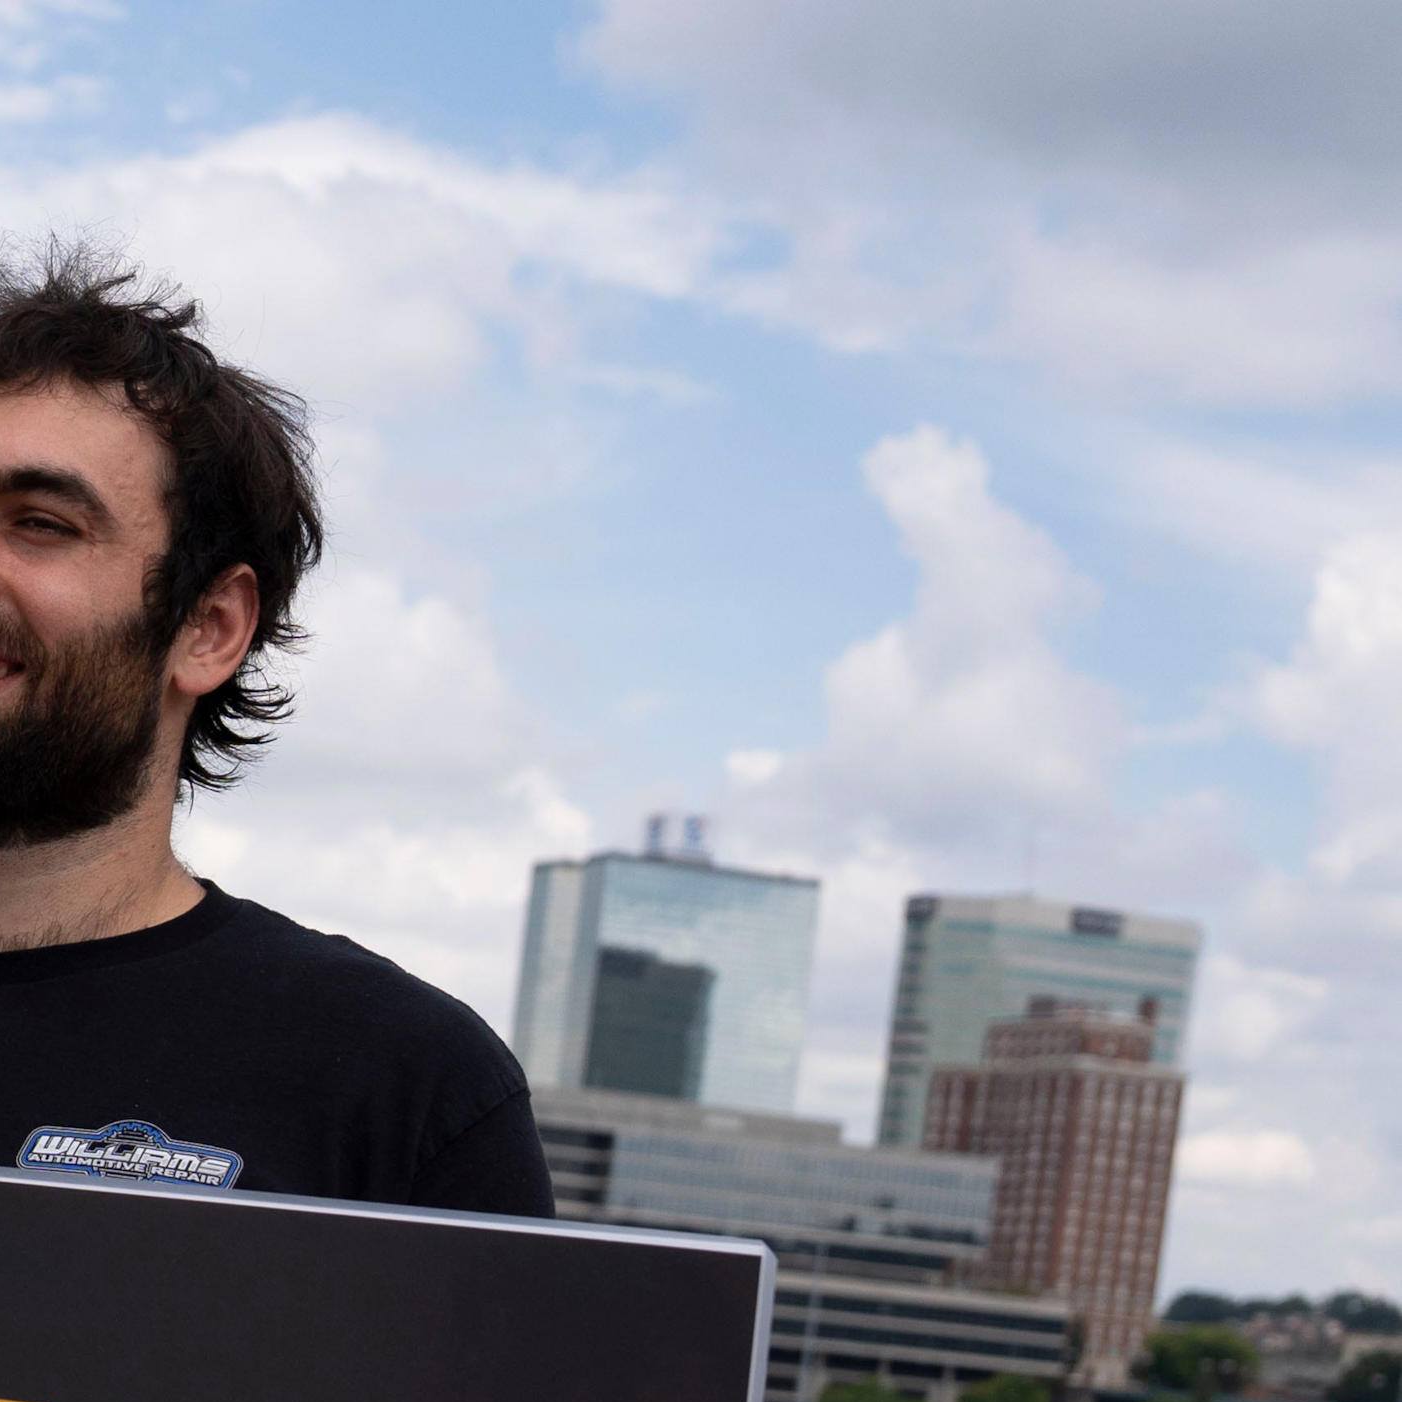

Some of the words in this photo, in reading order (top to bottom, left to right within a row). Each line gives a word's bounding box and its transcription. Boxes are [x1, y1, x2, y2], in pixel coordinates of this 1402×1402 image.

[27, 1153, 146, 1173] AUTOMOTIVE
[151, 1166, 221, 1186] REPAIR
[33, 1135, 232, 1174] WILLIAMS
